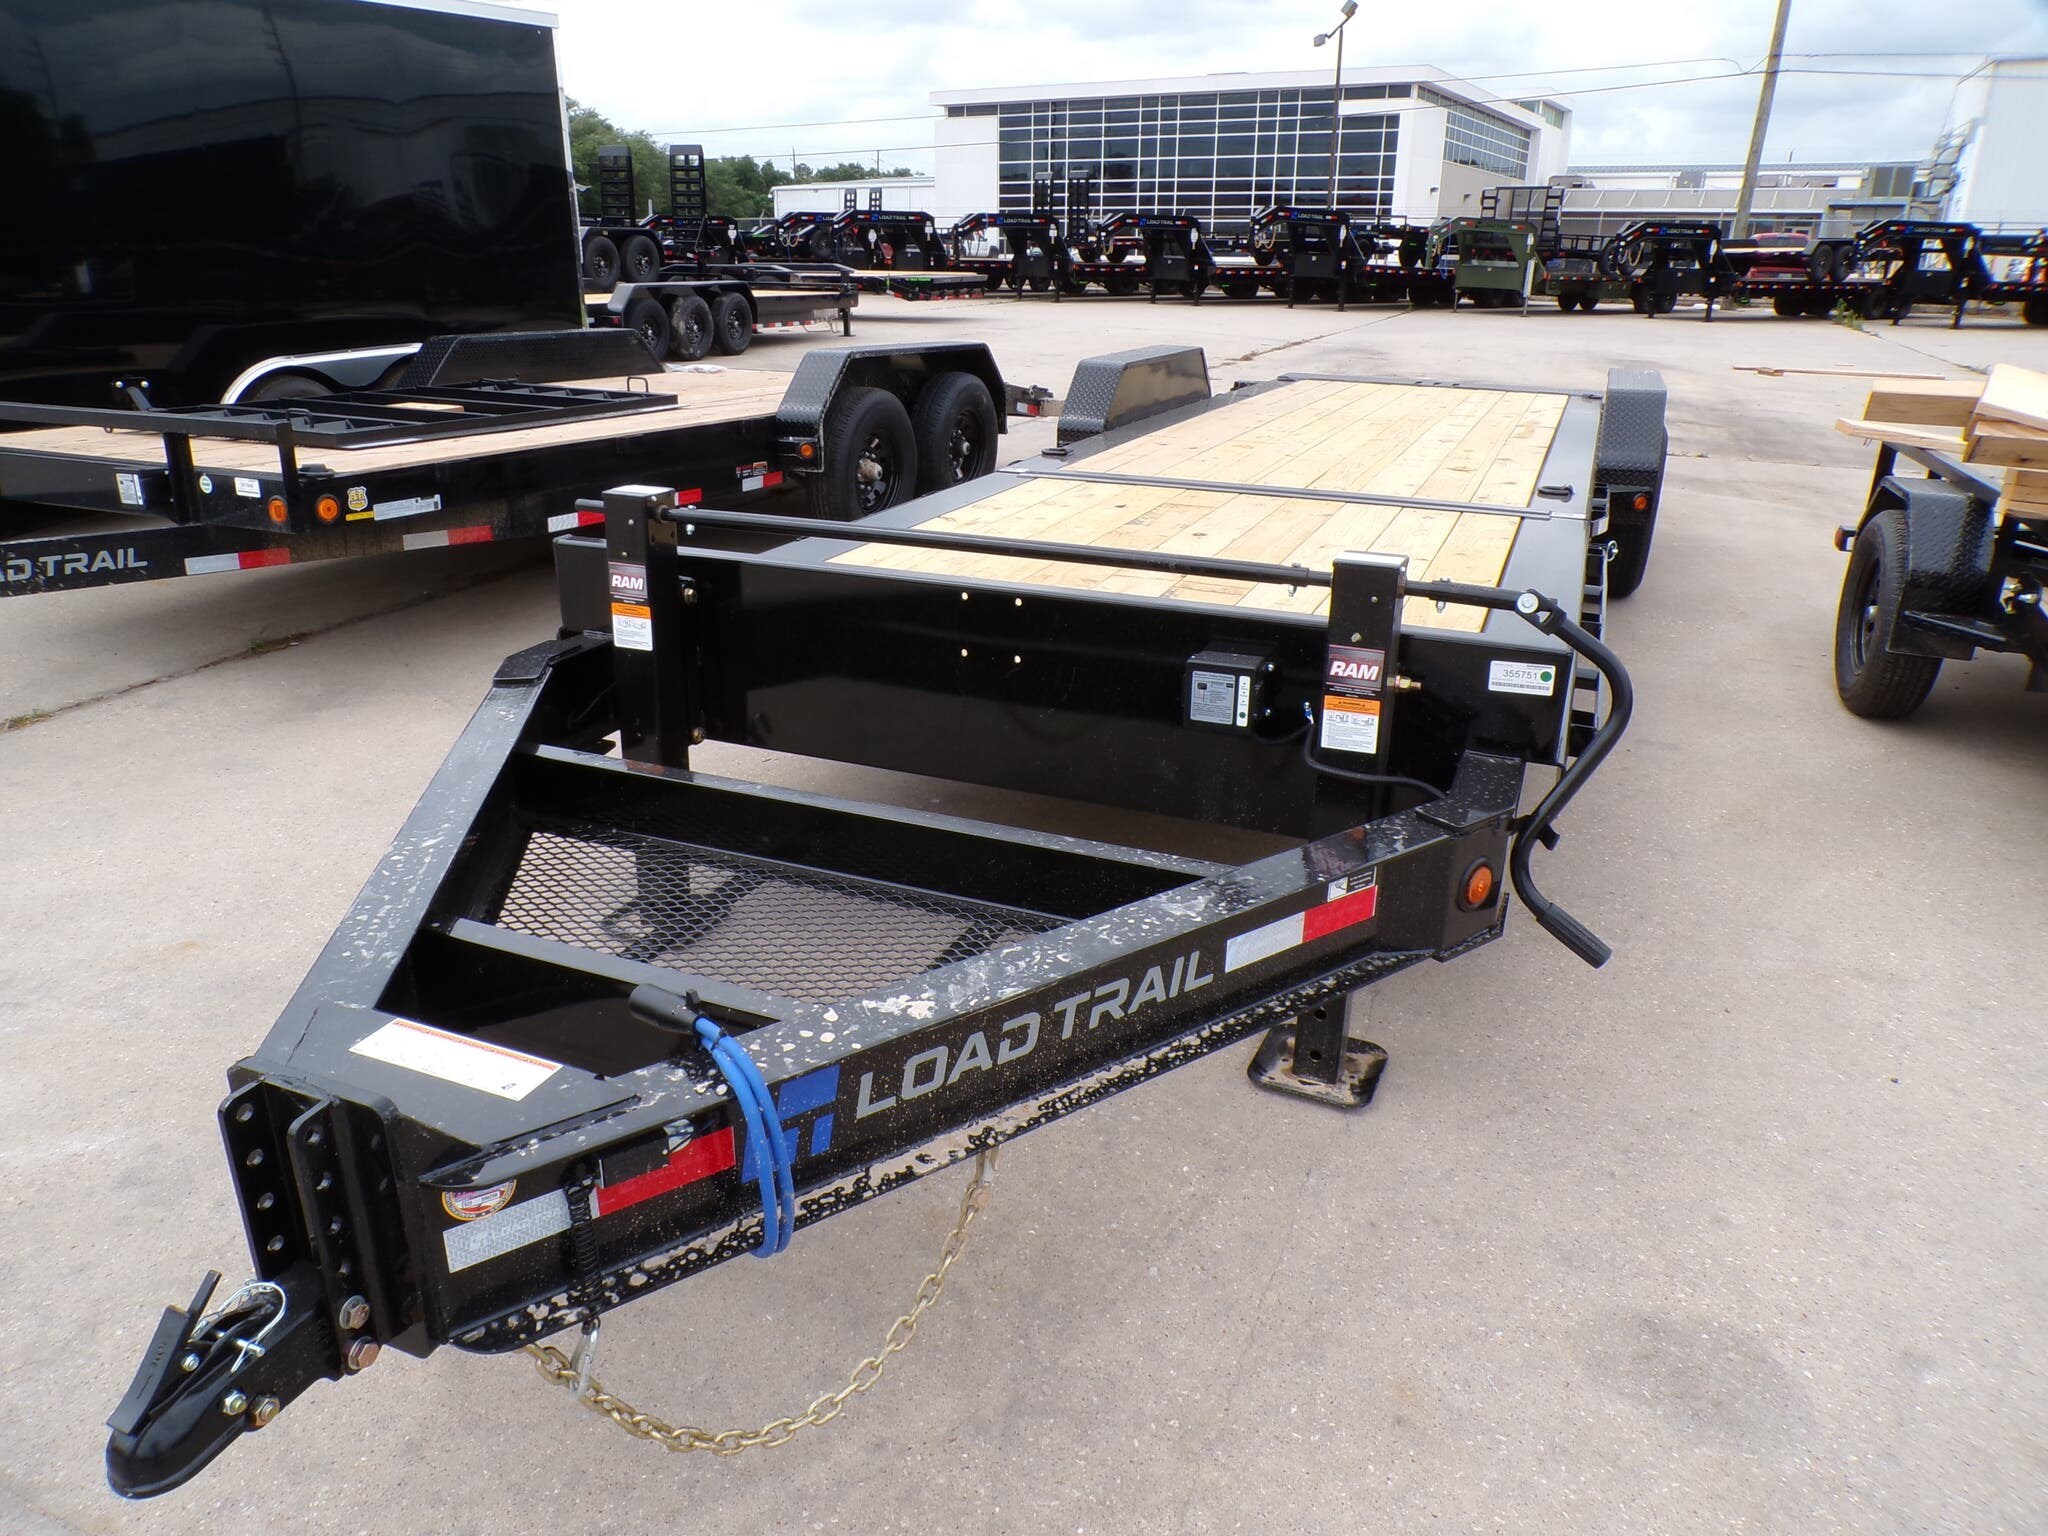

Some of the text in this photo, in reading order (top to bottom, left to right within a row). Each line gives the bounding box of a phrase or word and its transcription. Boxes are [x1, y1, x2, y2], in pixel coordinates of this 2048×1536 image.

[38, 547, 149, 577] TRAIL
[611, 574, 644, 591] RAM
[1329, 660, 1381, 682] RAM
[1502, 668, 1538, 681] 355751
[855, 949, 1214, 1120] LOAD TRAIL
